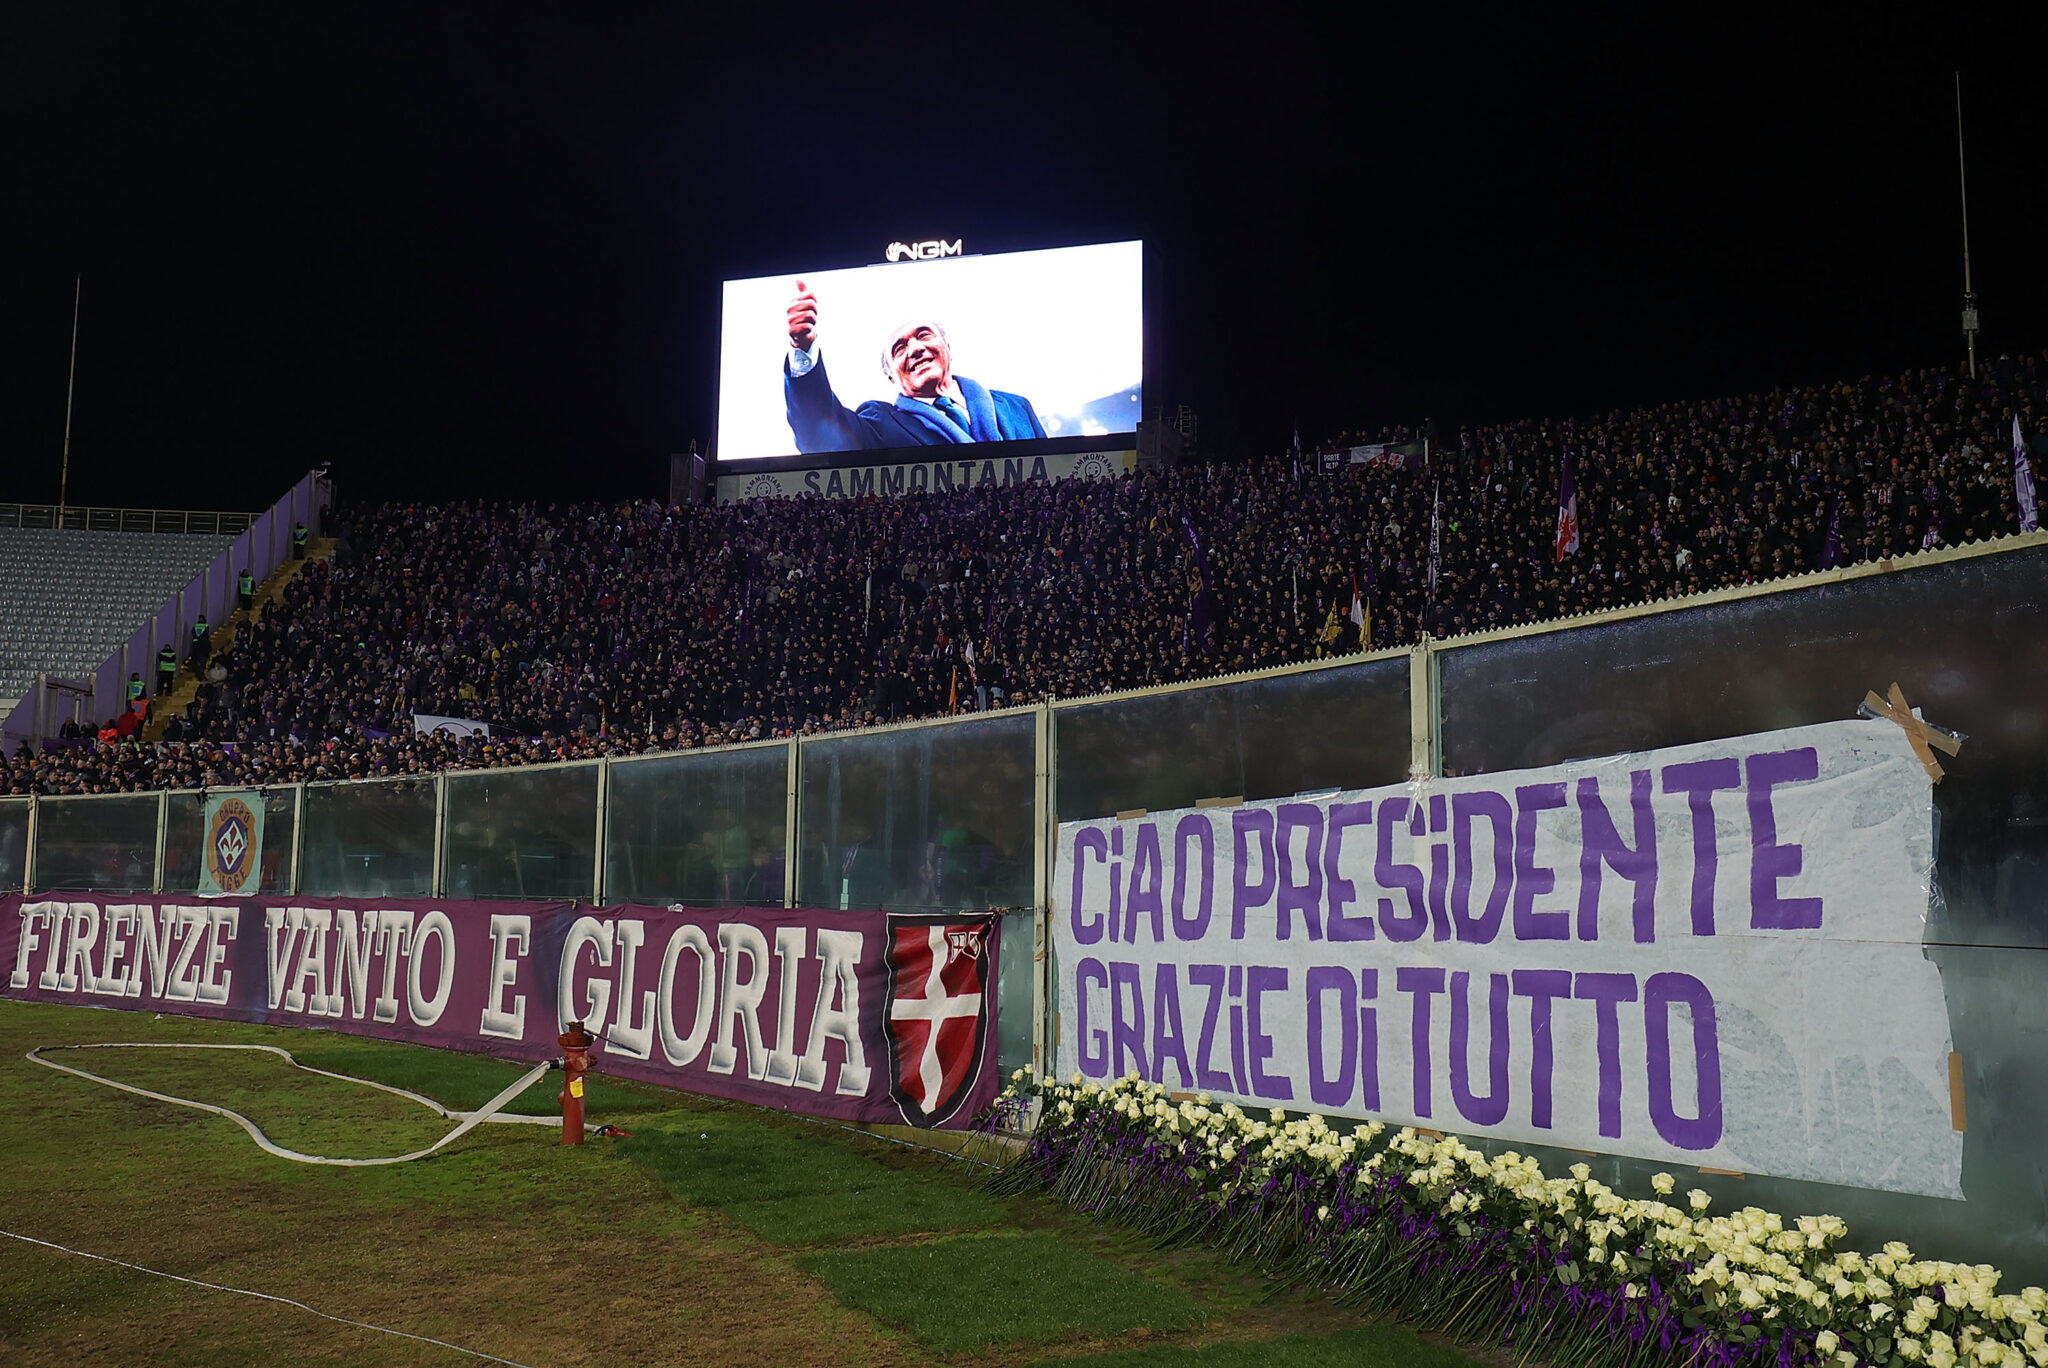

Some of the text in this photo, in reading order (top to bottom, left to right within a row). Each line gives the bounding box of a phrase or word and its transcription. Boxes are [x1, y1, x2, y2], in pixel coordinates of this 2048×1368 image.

[886, 239, 962, 262] NGM
[1072, 453, 1115, 476] SAMMONTANA
[744, 474, 782, 496] SAMMONTANA
[804, 456, 1049, 499] SAMMONTANA
[219, 802, 250, 824] GRUPPO
[10, 901, 871, 1097] FIRENZE VANTO E GLORIA
[1397, 966, 1723, 1151] TUTTO
